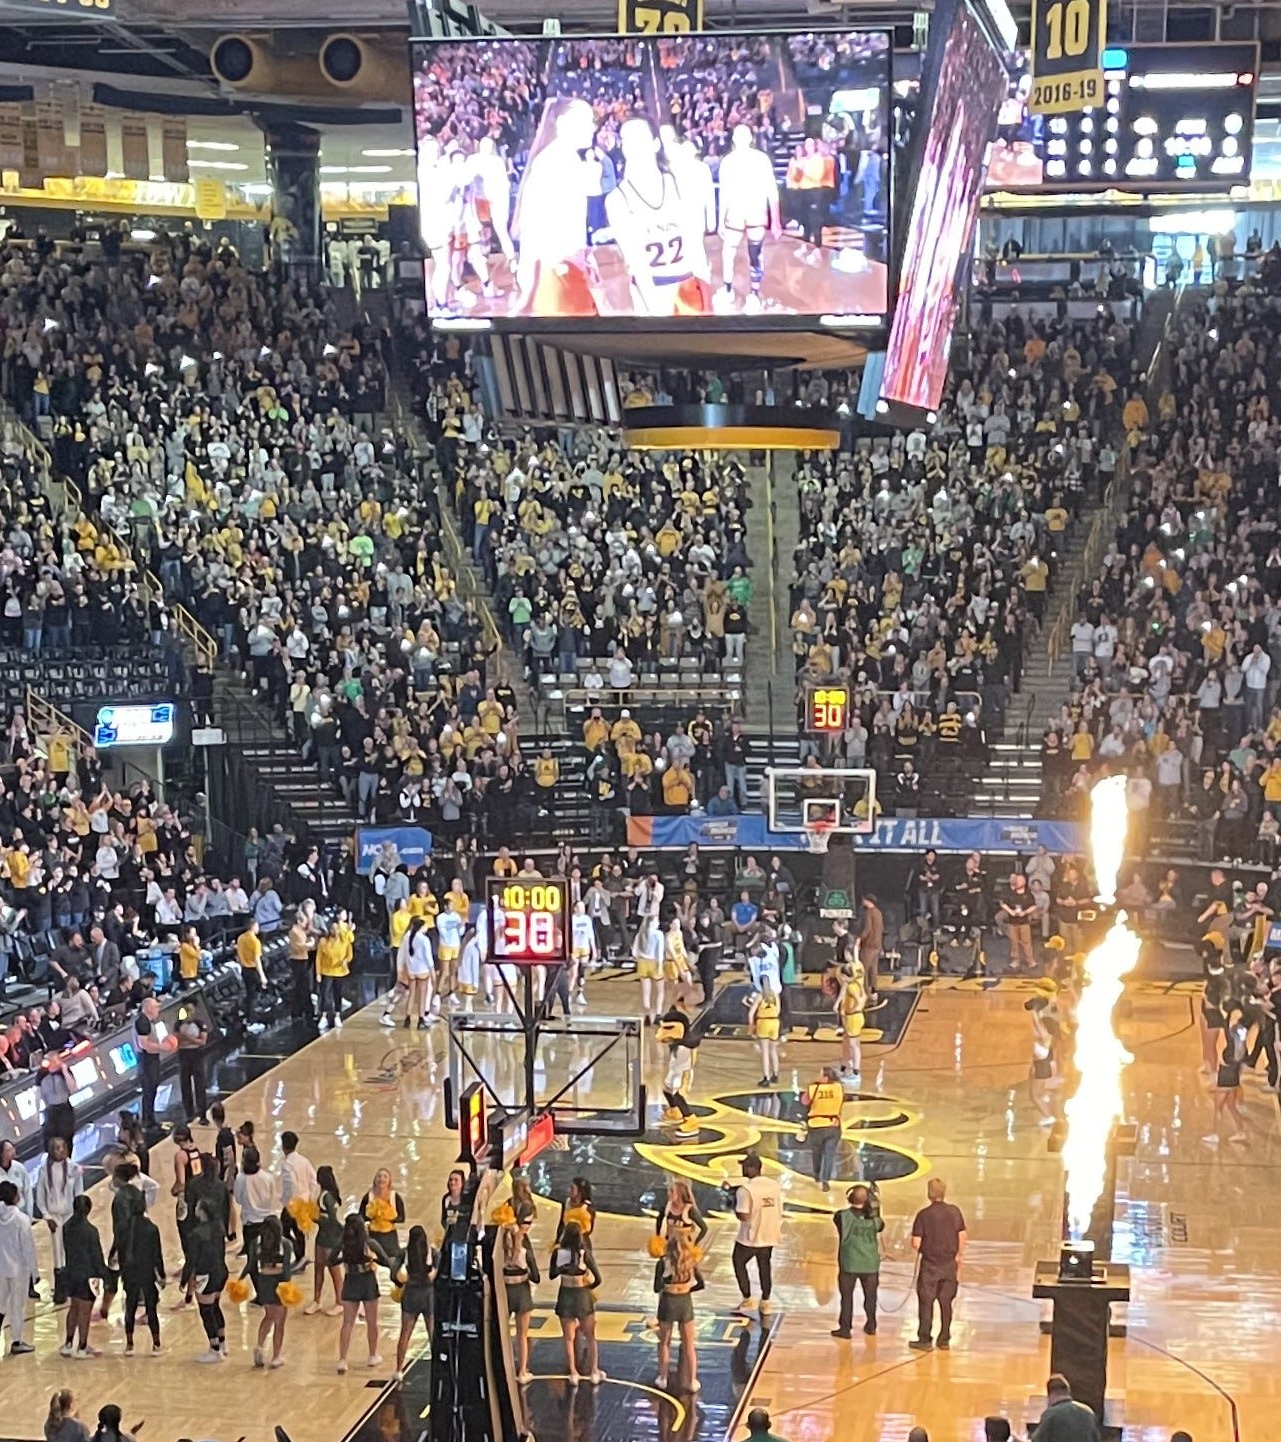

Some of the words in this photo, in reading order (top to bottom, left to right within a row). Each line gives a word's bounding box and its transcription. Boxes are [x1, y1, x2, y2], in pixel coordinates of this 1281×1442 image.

[1046, 0, 1090, 60] 10
[1034, 79, 1097, 106] 2016-19
[645, 235, 684, 268] 22
[814, 704, 842, 727] 30
[869, 820, 898, 845] IT
[900, 820, 942, 845] ALL
[503, 885, 560, 911] 10:00
